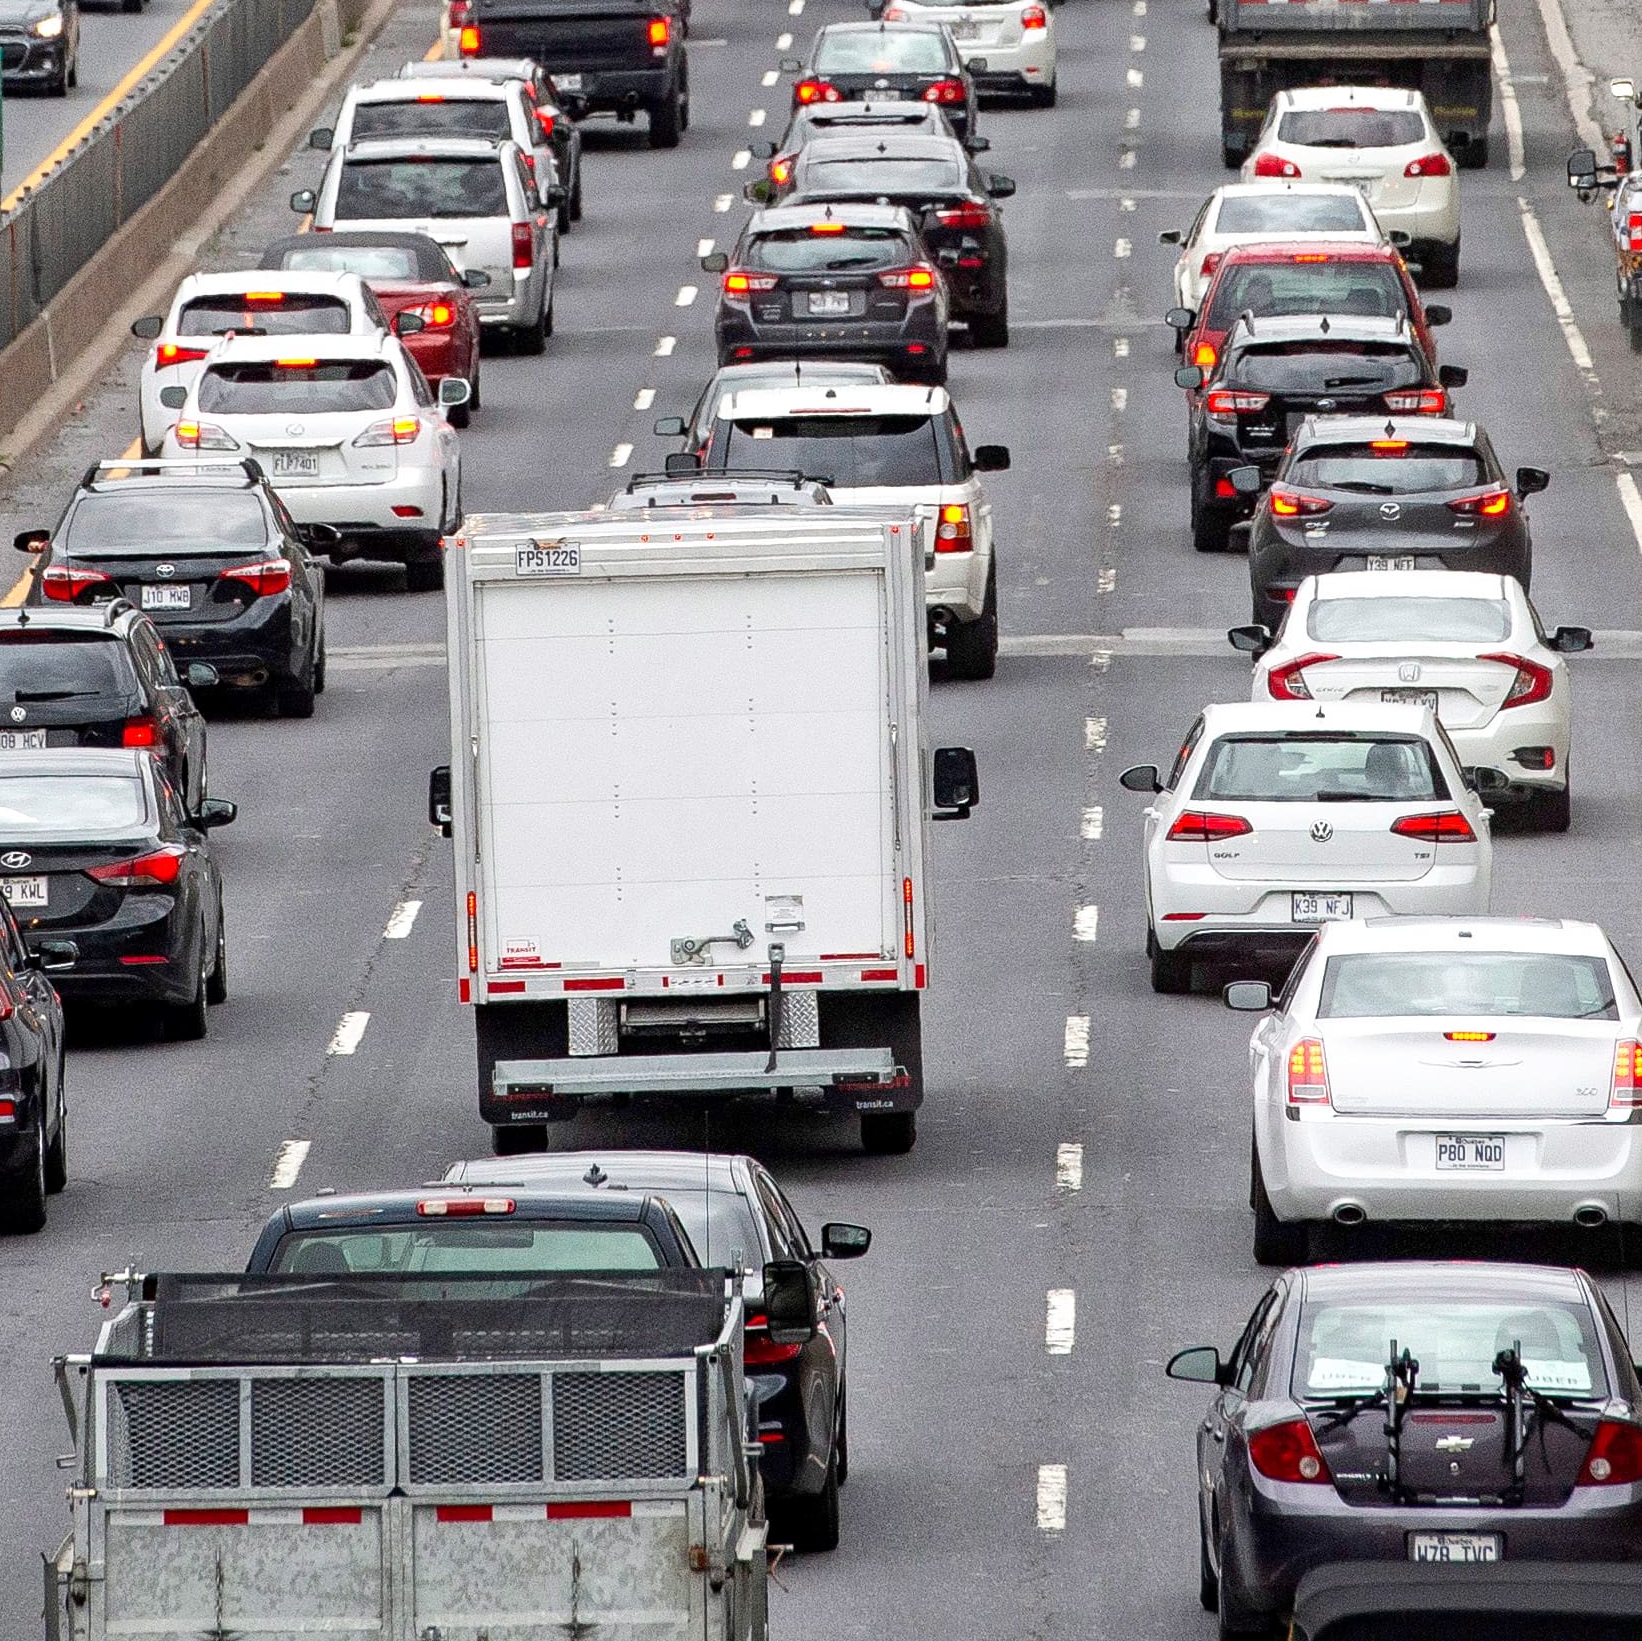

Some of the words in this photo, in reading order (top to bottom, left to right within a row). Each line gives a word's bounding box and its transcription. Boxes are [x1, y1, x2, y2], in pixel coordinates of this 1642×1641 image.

[518, 550, 578, 567] FPS1226
[143, 590, 164, 604] J10
[21, 883, 45, 900] KWL
[1295, 899, 1318, 914] K39
[1326, 899, 1350, 915] NFJ
[506, 946, 536, 954] TRANSIT
[855, 1100, 894, 1110] transit.ca
[511, 1110, 549, 1121] transit.ca
[1439, 1144, 1466, 1162] P80
[1475, 1145, 1502, 1162] NQD
